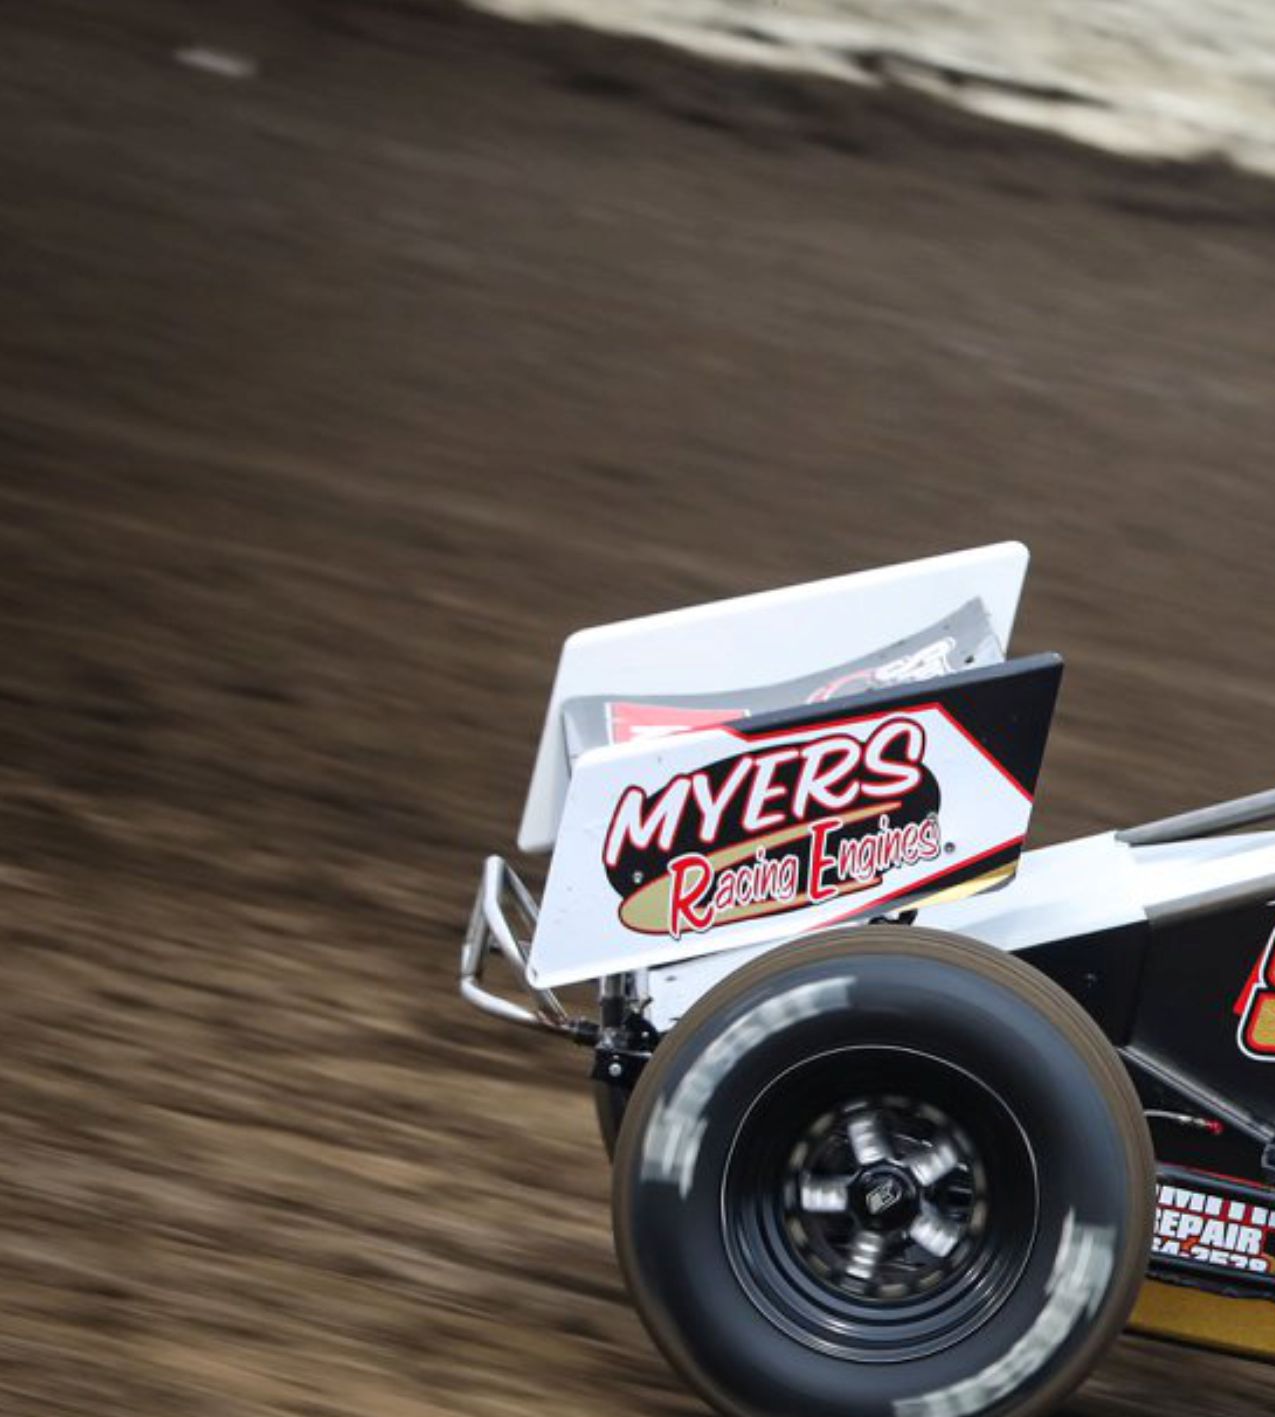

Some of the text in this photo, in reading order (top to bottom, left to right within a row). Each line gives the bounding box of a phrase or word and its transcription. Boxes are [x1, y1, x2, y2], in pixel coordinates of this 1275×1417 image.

[602, 716, 929, 869] MYERS
[666, 814, 941, 938] Racing Engines
